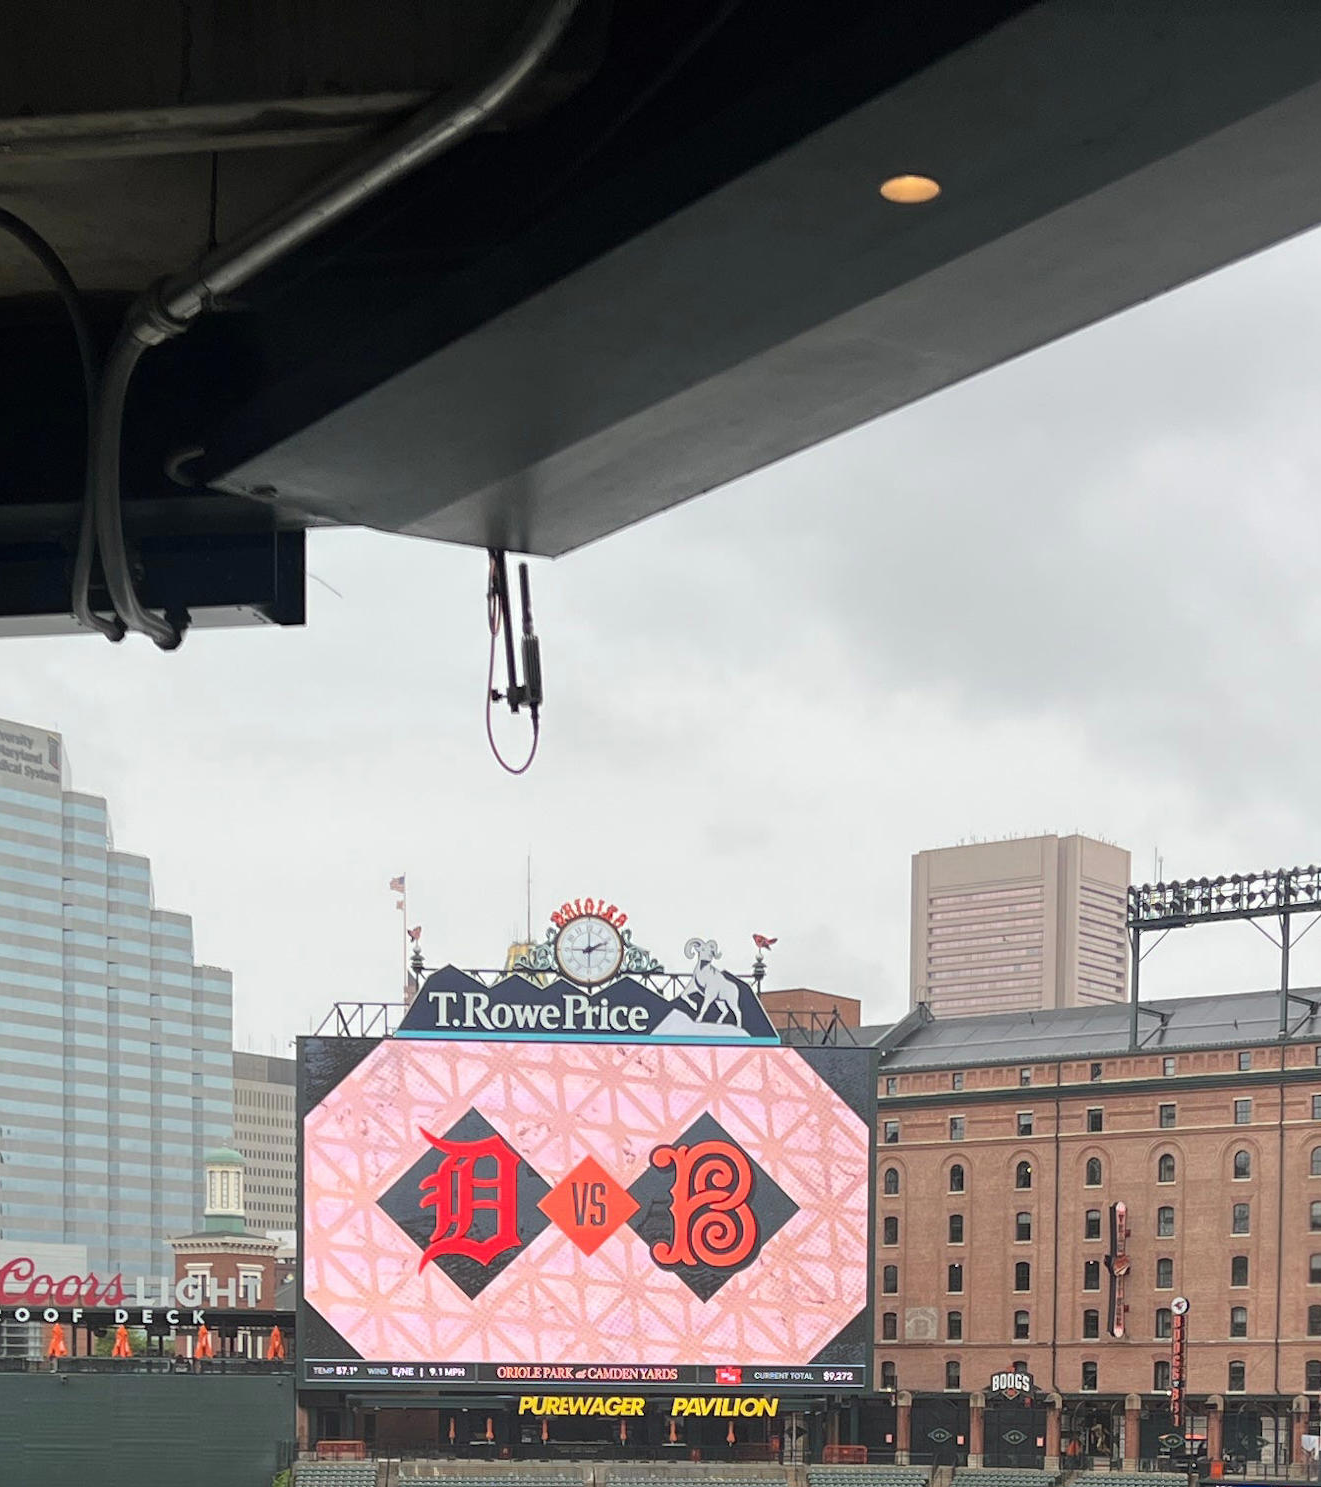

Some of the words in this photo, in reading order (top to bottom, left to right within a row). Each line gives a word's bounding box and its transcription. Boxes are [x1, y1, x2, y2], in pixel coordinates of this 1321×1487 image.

[563, 994, 650, 1032] Price
[418, 1126, 523, 1277] D
[571, 1182, 608, 1226] VS
[651, 1140, 760, 1270] B
[135, 1275, 264, 1310] LIGHT
[114, 1308, 206, 1325] DECK
[444, 1367, 466, 1377] MPH
[496, 1366, 542, 1380] ORIOLE
[543, 1366, 574, 1380] PARK
[587, 1367, 638, 1380] CAMDEN
[639, 1367, 679, 1381] YARDS
[789, 1371, 814, 1381] TOTAL
[823, 1370, 854, 1382] $9,272
[517, 1395, 646, 1417] PUREWAGER
[670, 1397, 778, 1418] PAVILION
